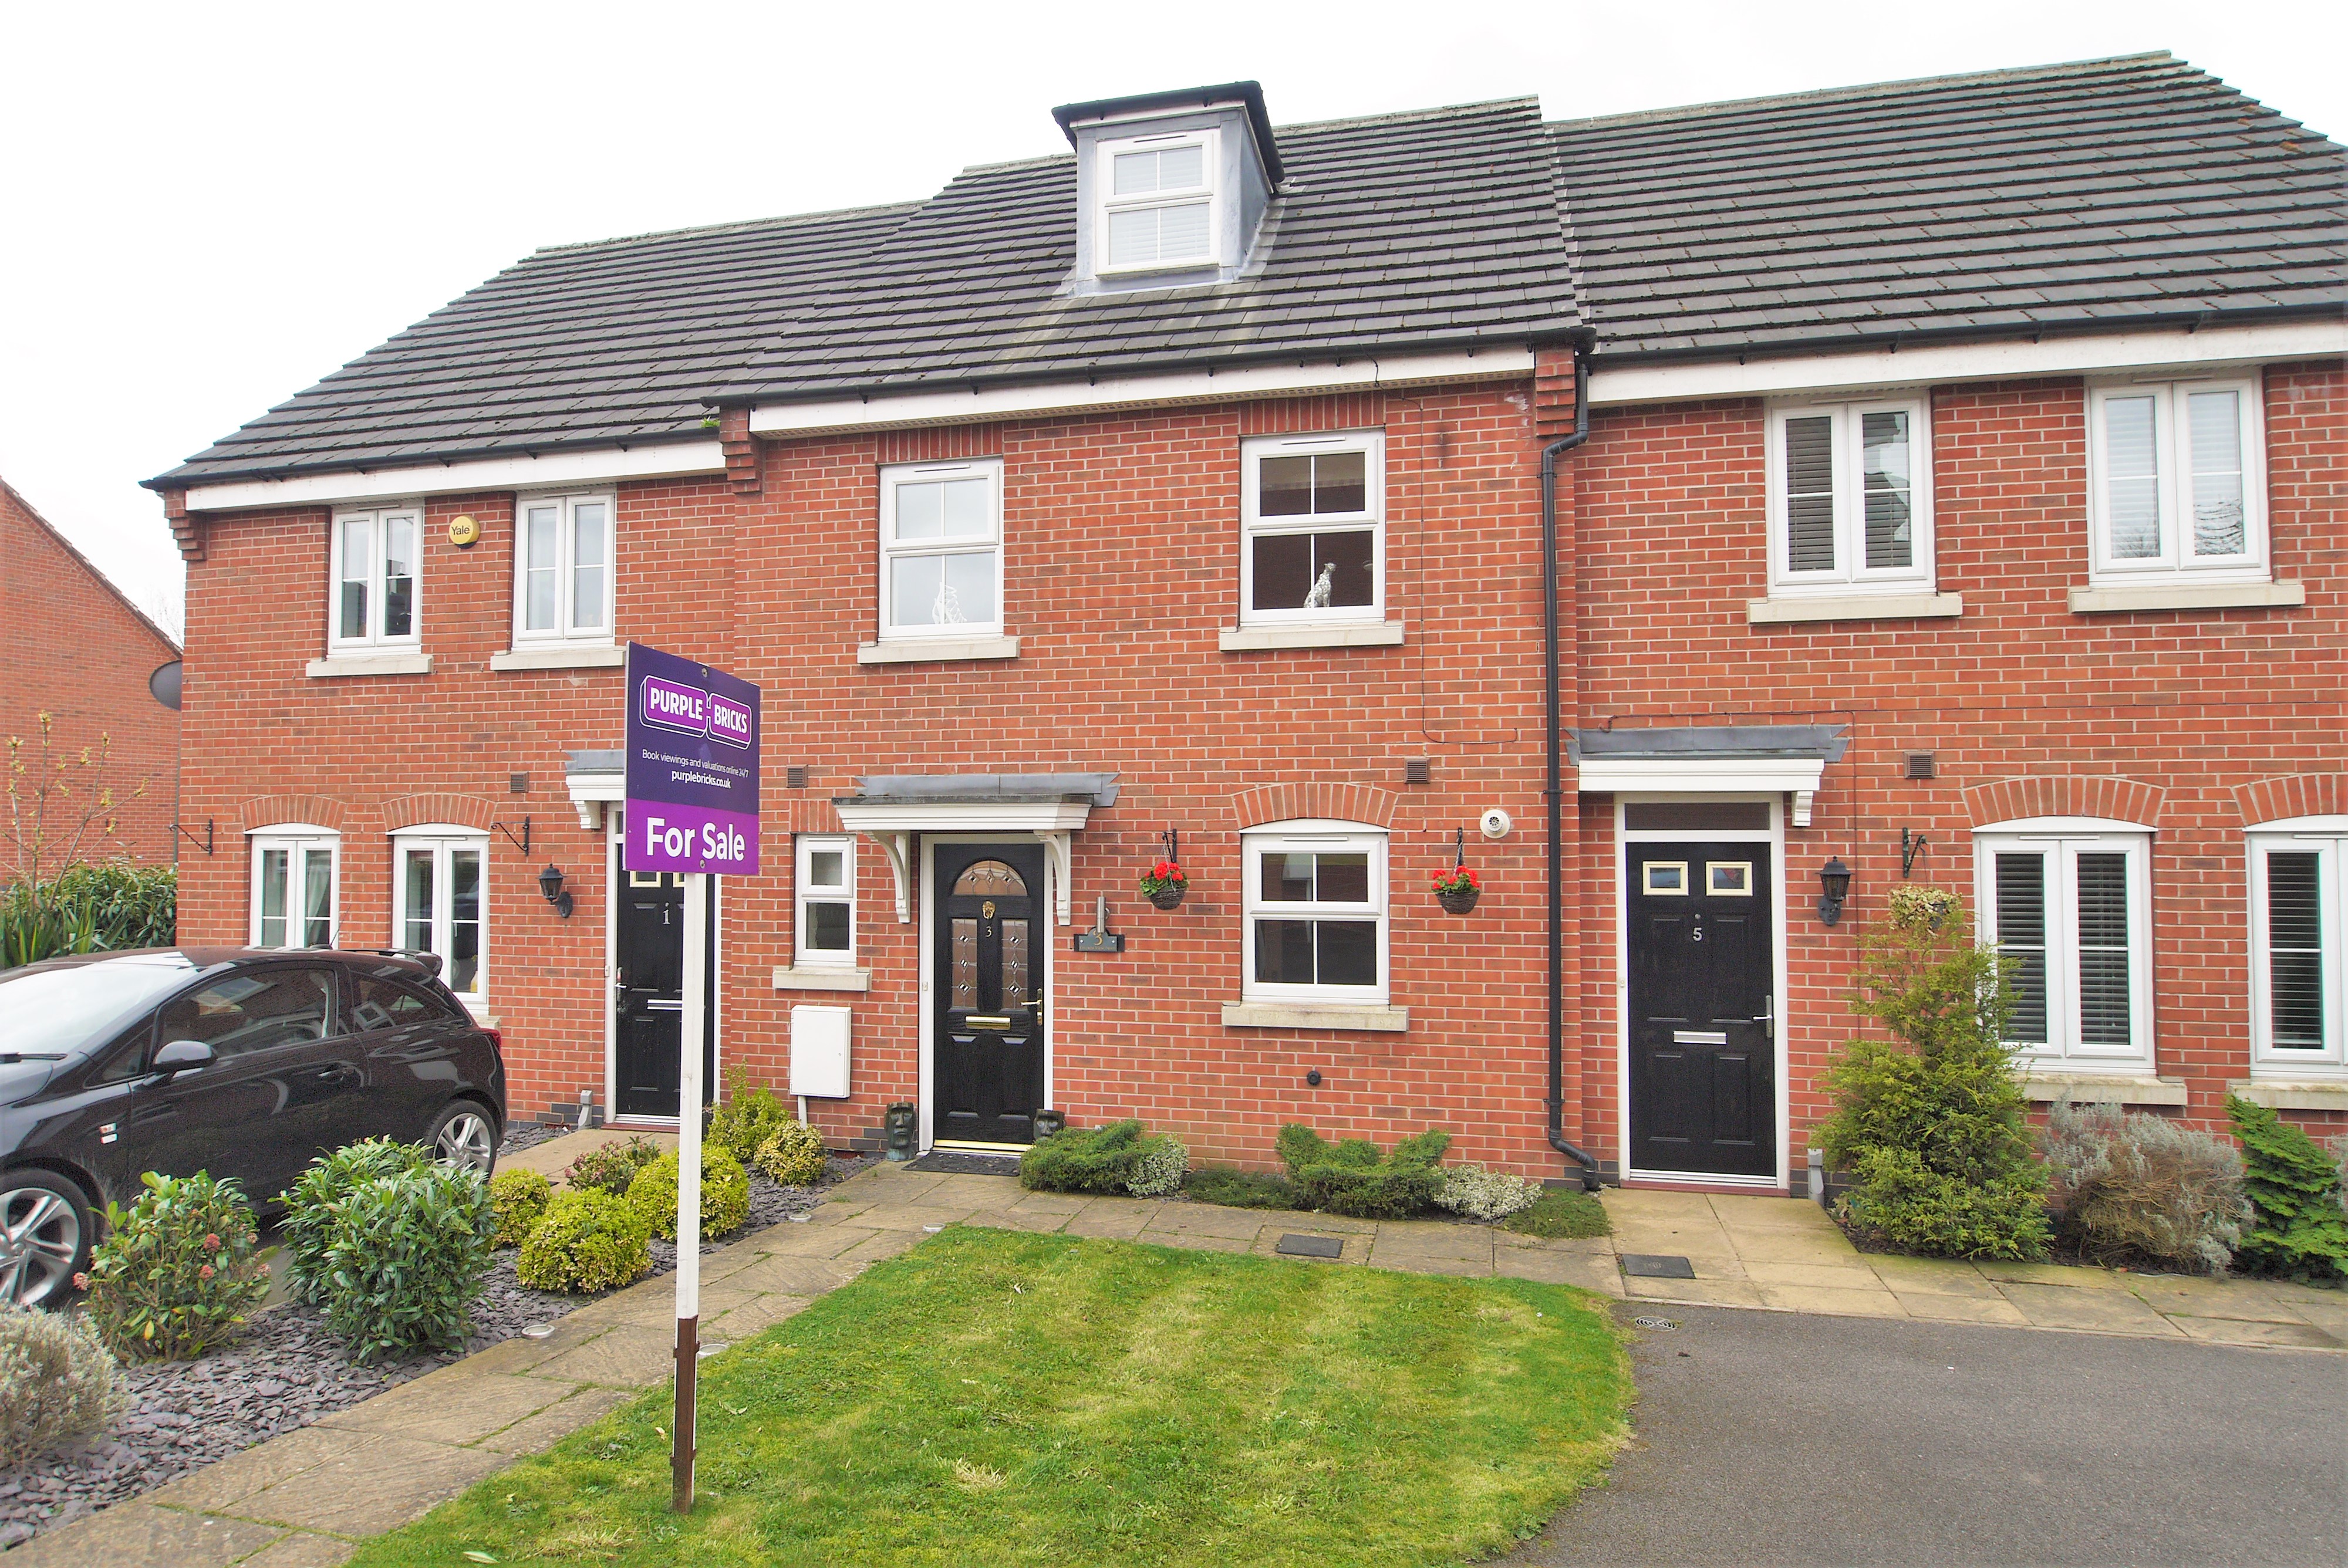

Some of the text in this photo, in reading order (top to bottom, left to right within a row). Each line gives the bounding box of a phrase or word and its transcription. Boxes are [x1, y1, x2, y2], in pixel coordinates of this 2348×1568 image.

[451, 525, 470, 535] Yale
[650, 687, 747, 734] PURPLE BRICKS
[642, 749, 749, 778] Book viewings and valuations online 24/7
[671, 771, 731, 789] purplebricks.co.uk
[647, 817, 745, 861] For Sale
[663, 909, 670, 925] 1
[986, 926, 992, 938] 3
[1093, 930, 1103, 945] 3
[1692, 927, 1702, 941] 5
